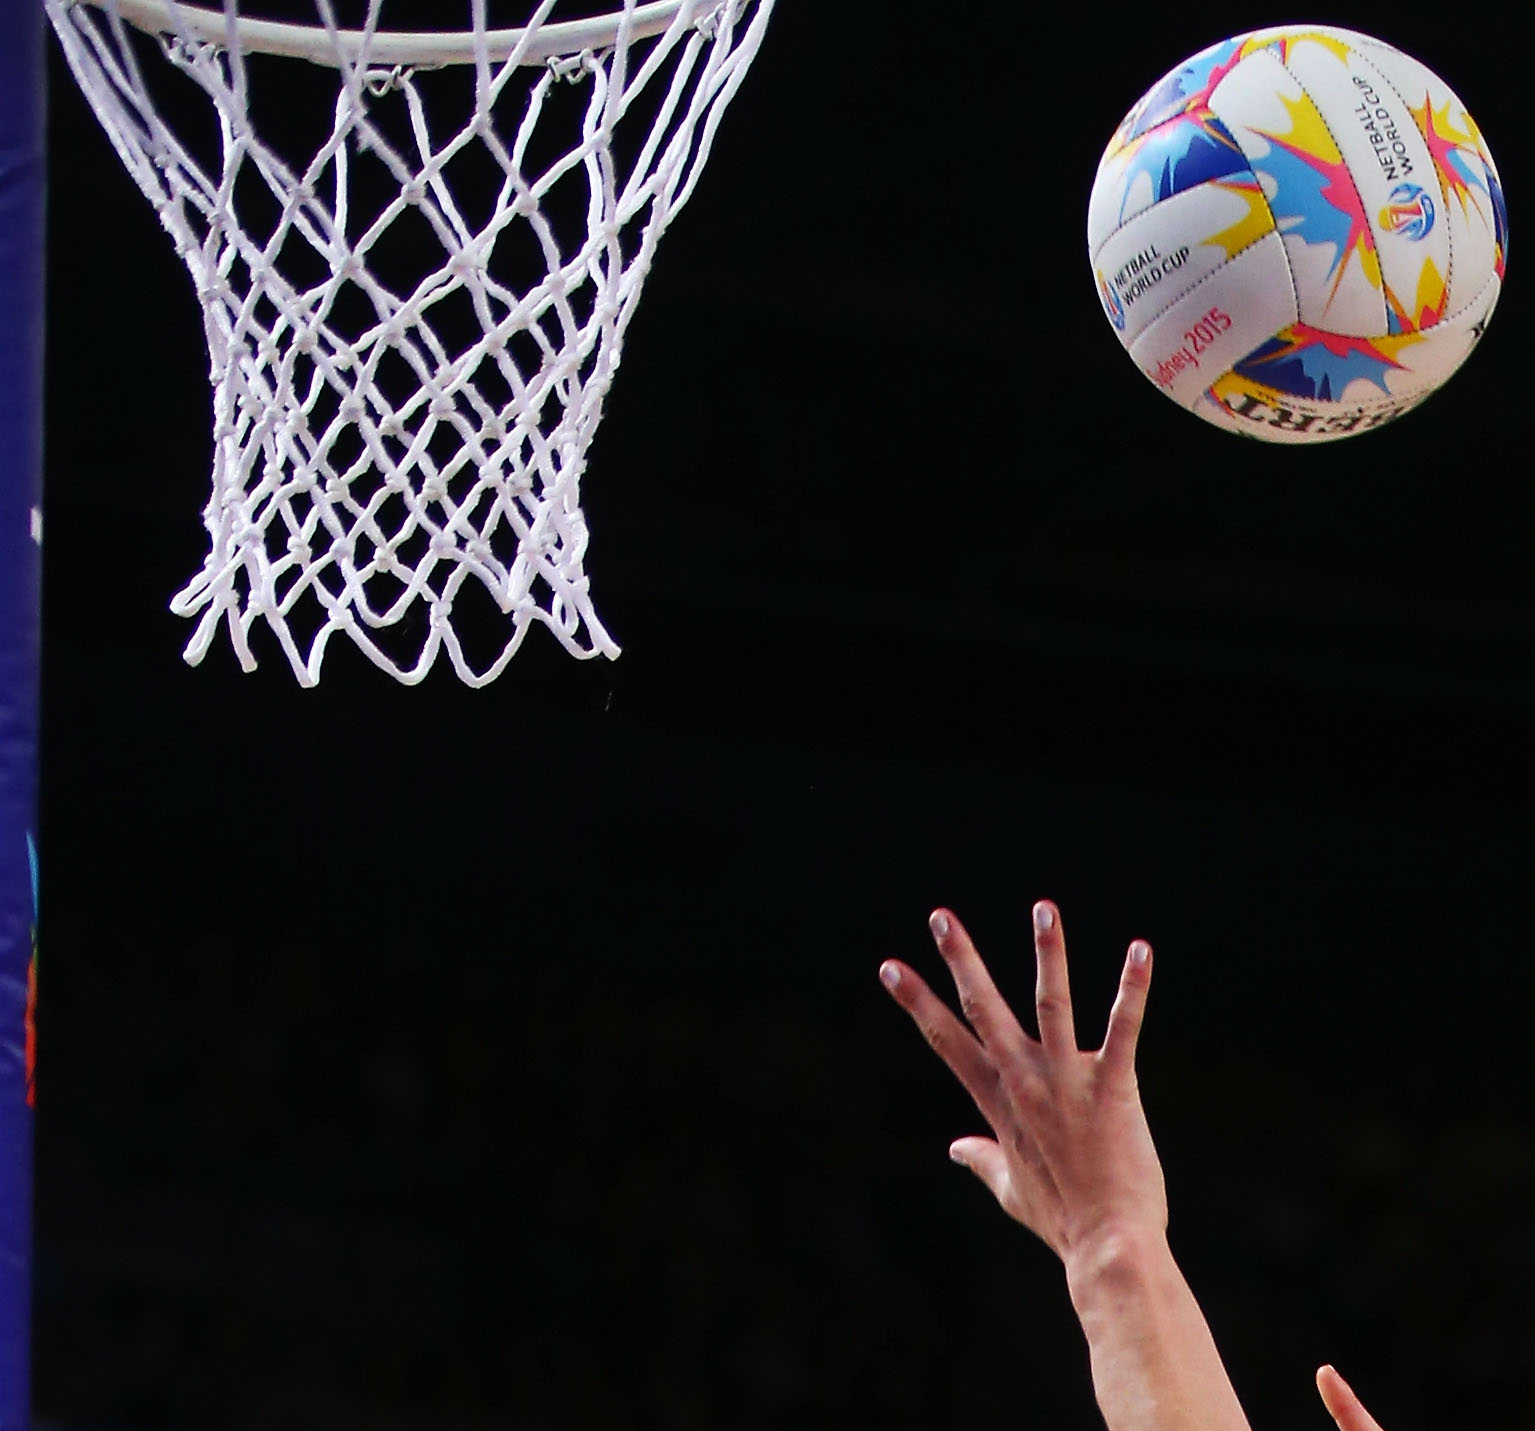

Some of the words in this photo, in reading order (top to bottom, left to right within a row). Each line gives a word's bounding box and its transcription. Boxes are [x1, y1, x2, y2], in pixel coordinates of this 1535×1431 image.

[1353, 77, 1380, 105] CUP
[1355, 102, 1398, 180] NETBALL
[1376, 108, 1413, 176] WORLD
[1114, 245, 1160, 289] NETBALL
[1123, 268, 1162, 306] WORLD
[1162, 247, 1190, 274] CUP
[1184, 306, 1232, 354] 2015
